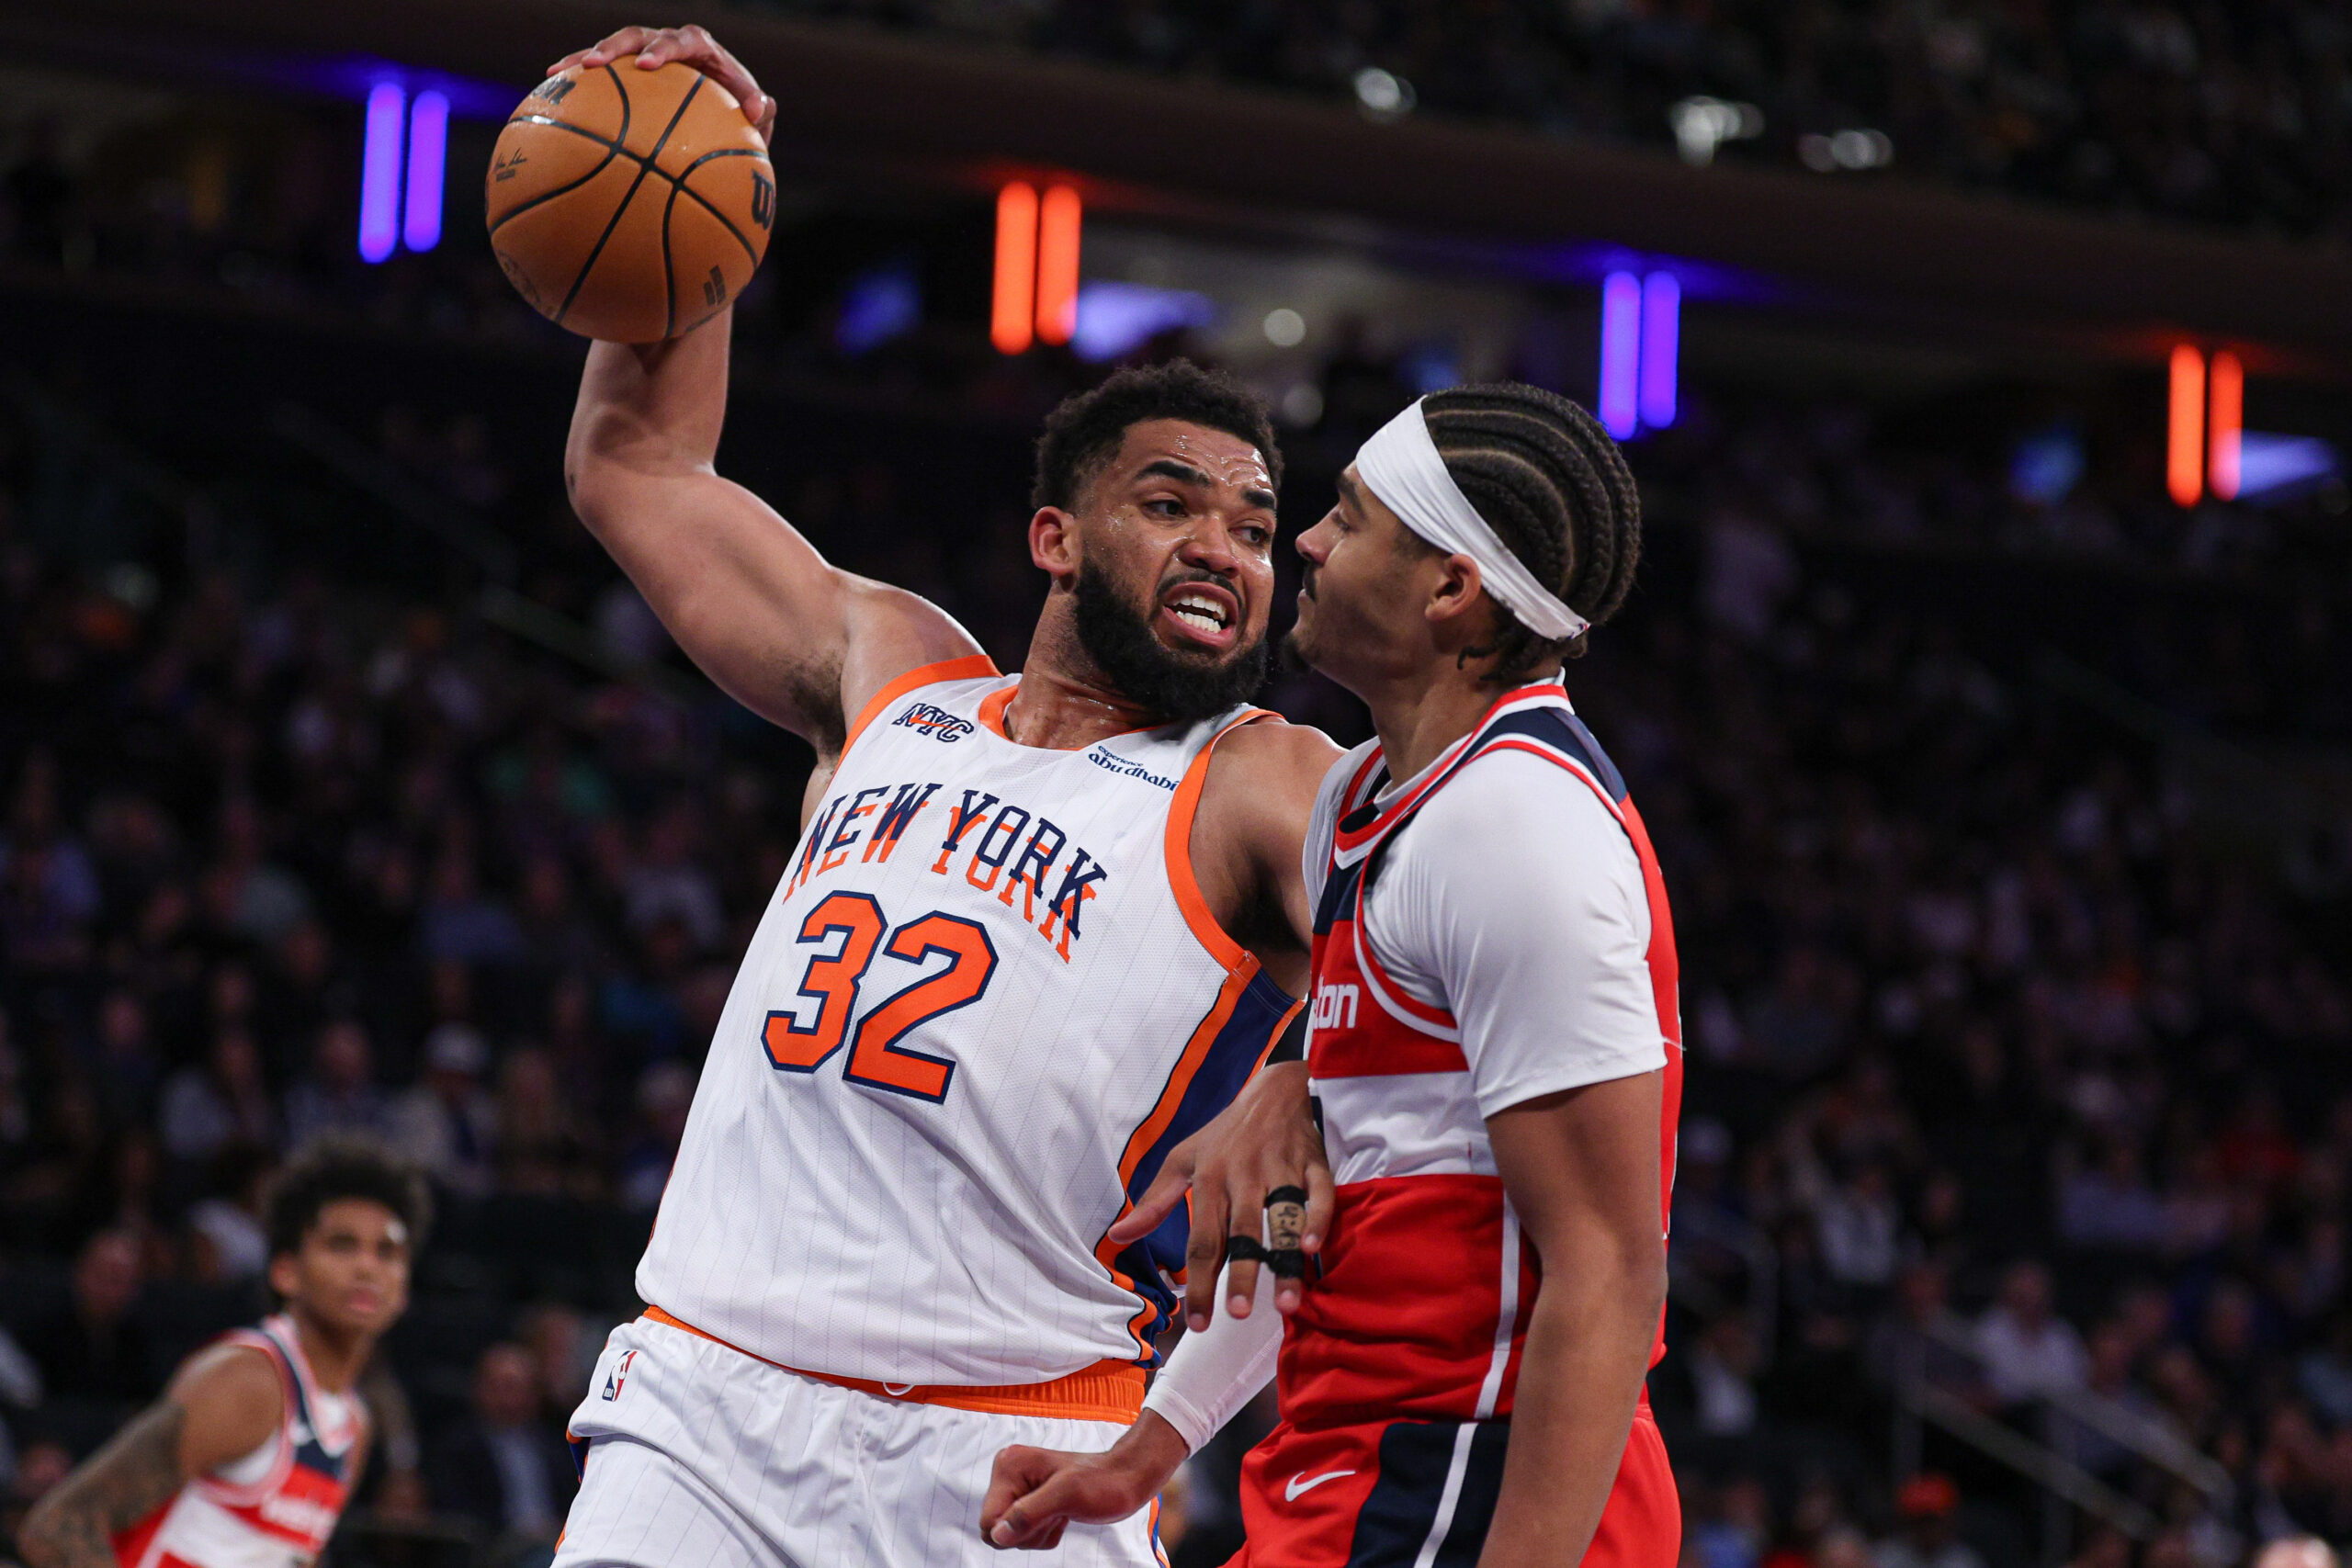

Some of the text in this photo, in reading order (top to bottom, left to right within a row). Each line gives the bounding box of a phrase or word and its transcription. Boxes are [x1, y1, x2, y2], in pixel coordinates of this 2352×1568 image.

[891, 703, 975, 742] NYC
[1088, 753, 1181, 791] abu dhabi
[1097, 745, 1144, 767] experience
[783, 784, 1108, 964] NEW YORK
[760, 889, 1000, 1105] 32
